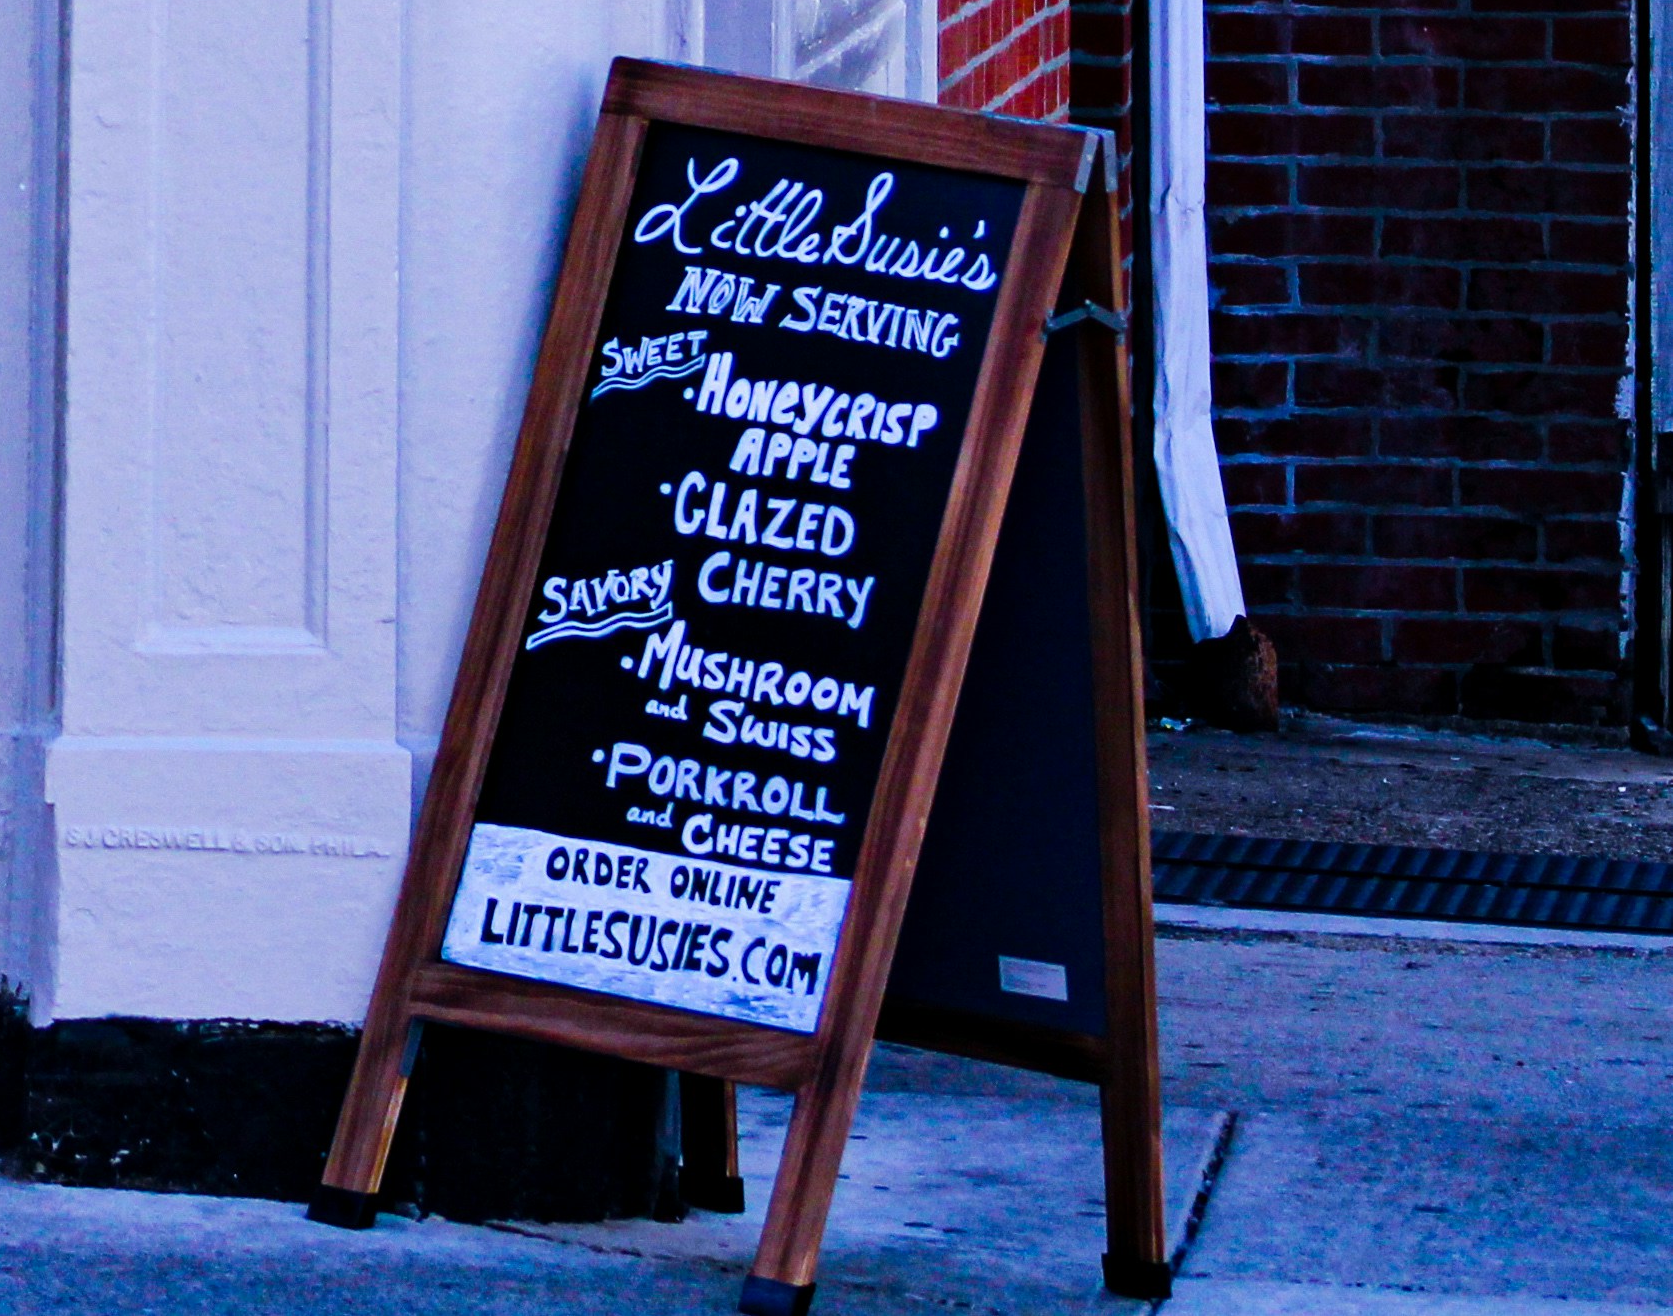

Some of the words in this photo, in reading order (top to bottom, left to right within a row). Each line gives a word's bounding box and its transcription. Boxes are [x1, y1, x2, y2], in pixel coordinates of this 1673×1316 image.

[634, 156, 824, 265] Little
[821, 171, 997, 291] Susie's
[665, 265, 780, 326] NOW
[778, 285, 960, 358] SERVING
[601, 330, 709, 377] SWEET
[729, 427, 856, 490] APPLE
[673, 470, 856, 557] GLAZED
[537, 559, 674, 624] SAVORY
[697, 552, 876, 629] CHERRY
[637, 619, 876, 729] MUSHROOM
[645, 695, 688, 722] and
[702, 700, 837, 762] SWISS
[606, 741, 846, 824] PORKROLL
[626, 802, 674, 828] and
[681, 813, 835, 872] CHEESE
[545, 845, 652, 895] ORDER
[669, 865, 781, 914] ONLINE
[479, 897, 822, 996] LITTLESUSIES.COM
